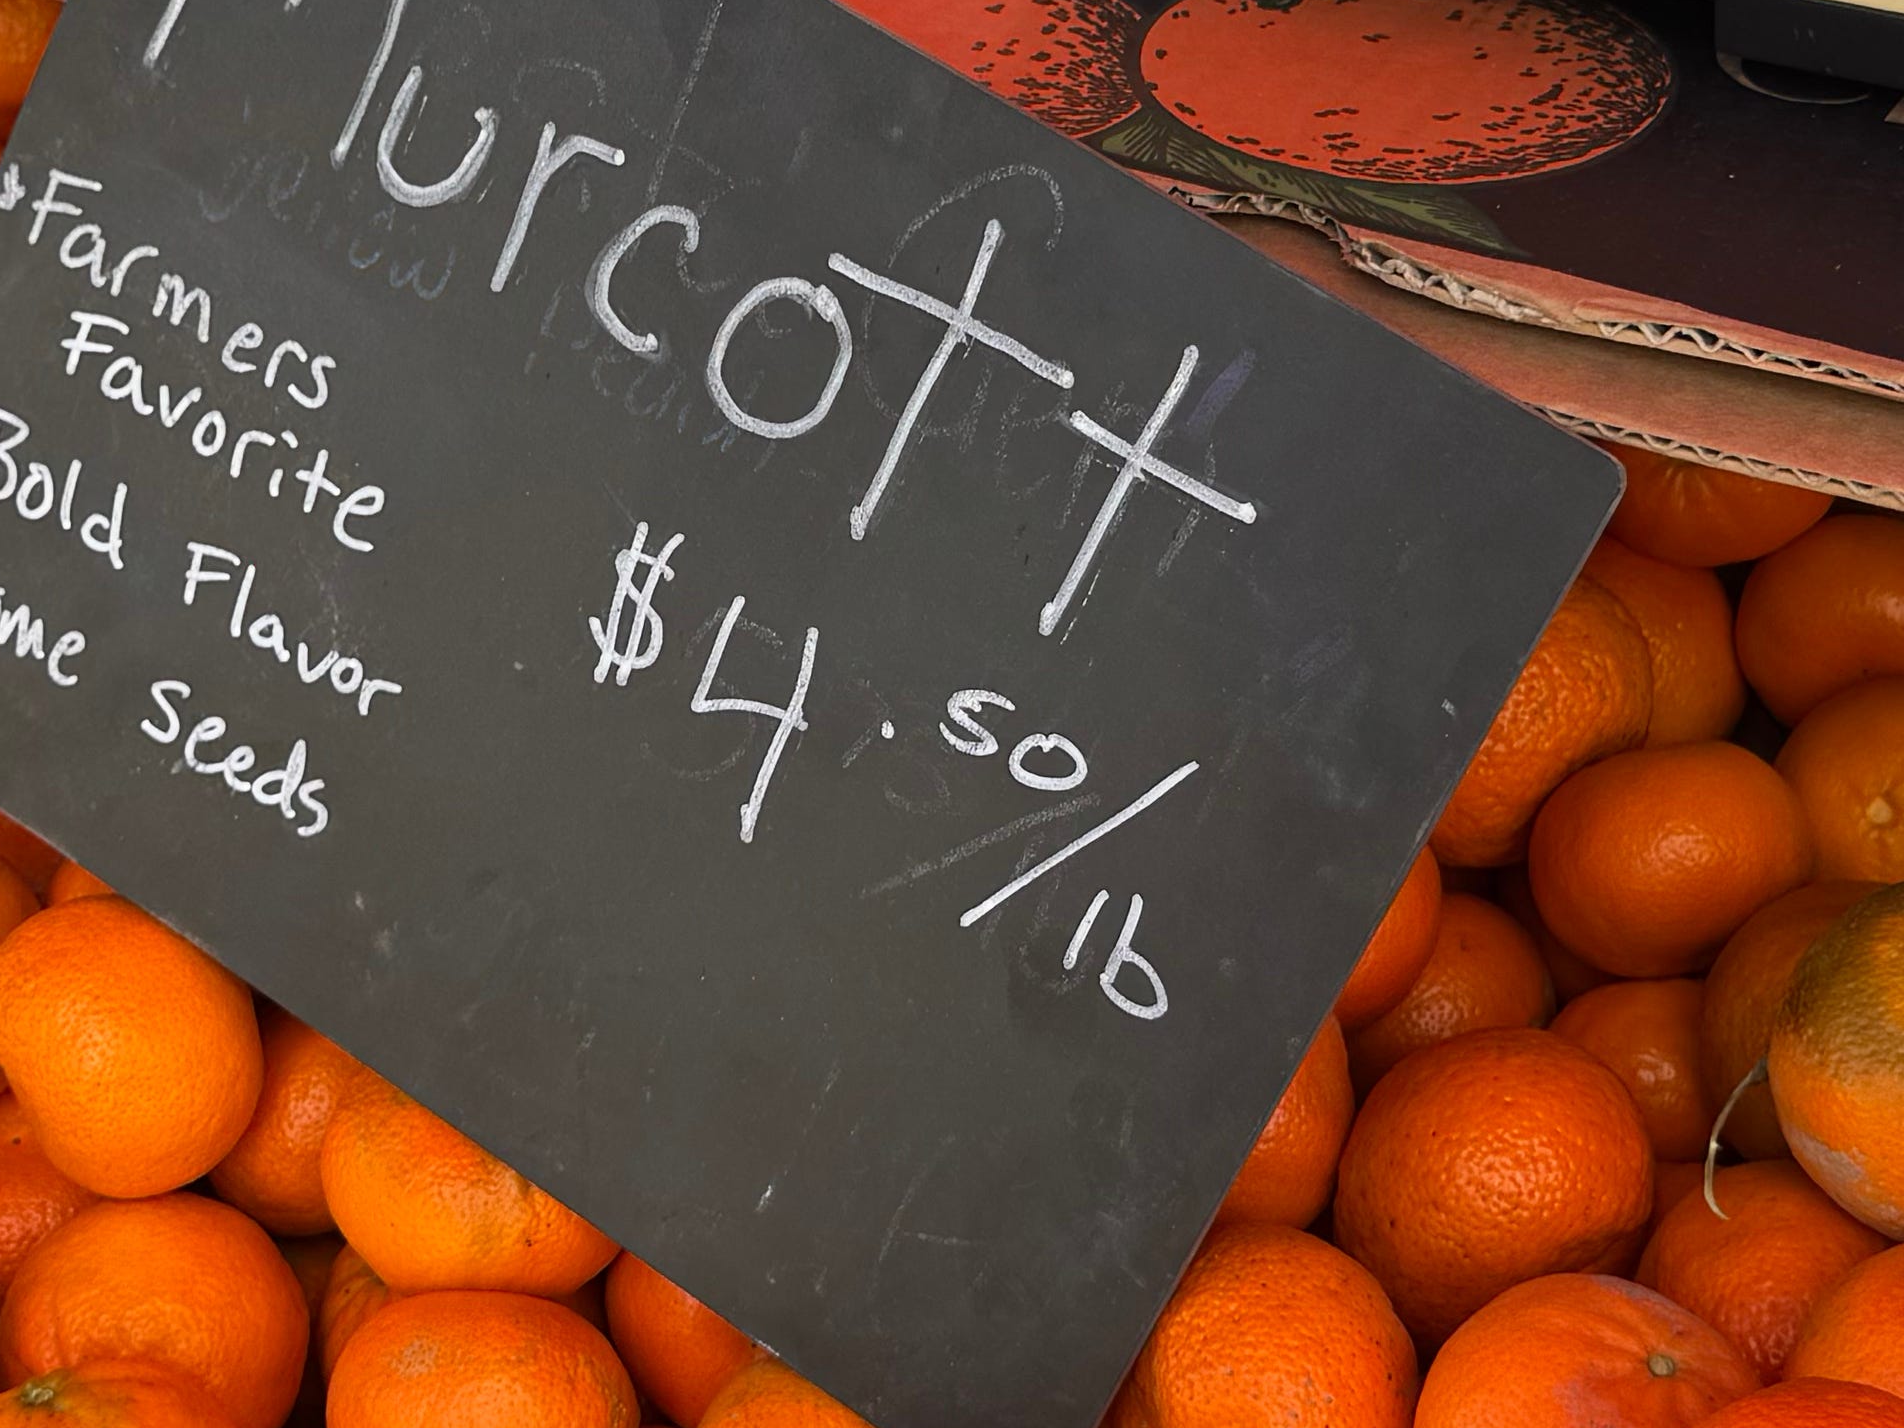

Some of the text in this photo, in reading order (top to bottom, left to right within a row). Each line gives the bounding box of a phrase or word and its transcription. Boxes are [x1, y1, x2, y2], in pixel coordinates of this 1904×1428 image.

[31, 169, 336, 410] Farmers
[61, 311, 386, 552] Favorite
[184, 542, 402, 716] Flavor
